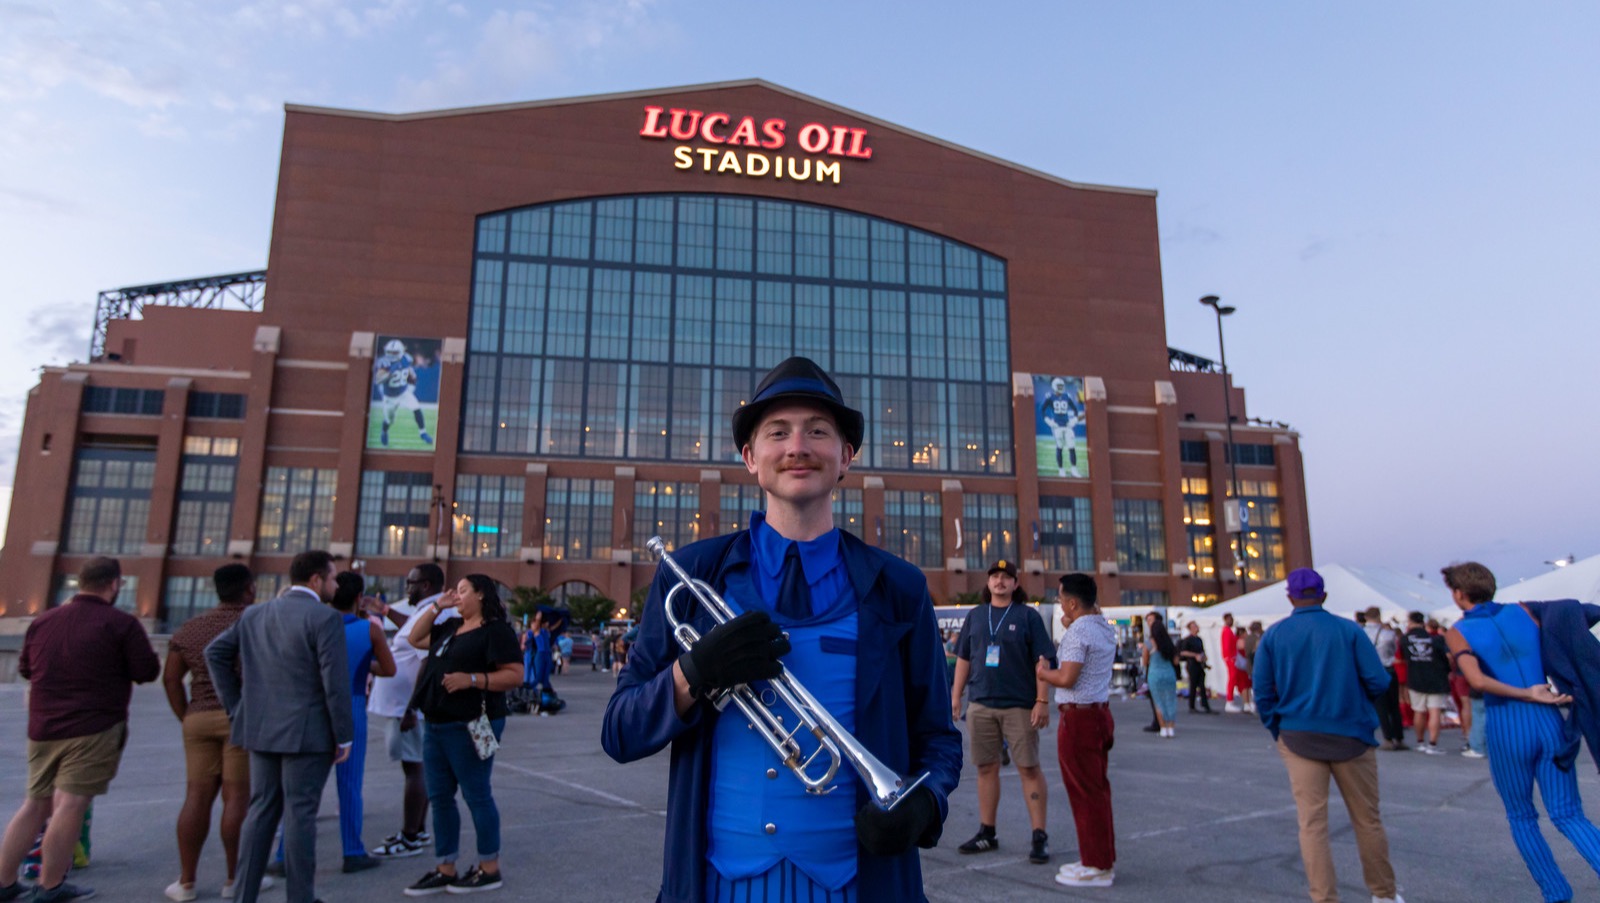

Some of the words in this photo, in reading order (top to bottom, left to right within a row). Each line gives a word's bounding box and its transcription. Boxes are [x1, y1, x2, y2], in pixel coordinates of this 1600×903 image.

[639, 105, 786, 148] LUCAS
[798, 122, 873, 158] OIL
[673, 146, 841, 184] STADIUM
[1053, 400, 1068, 414] 99
